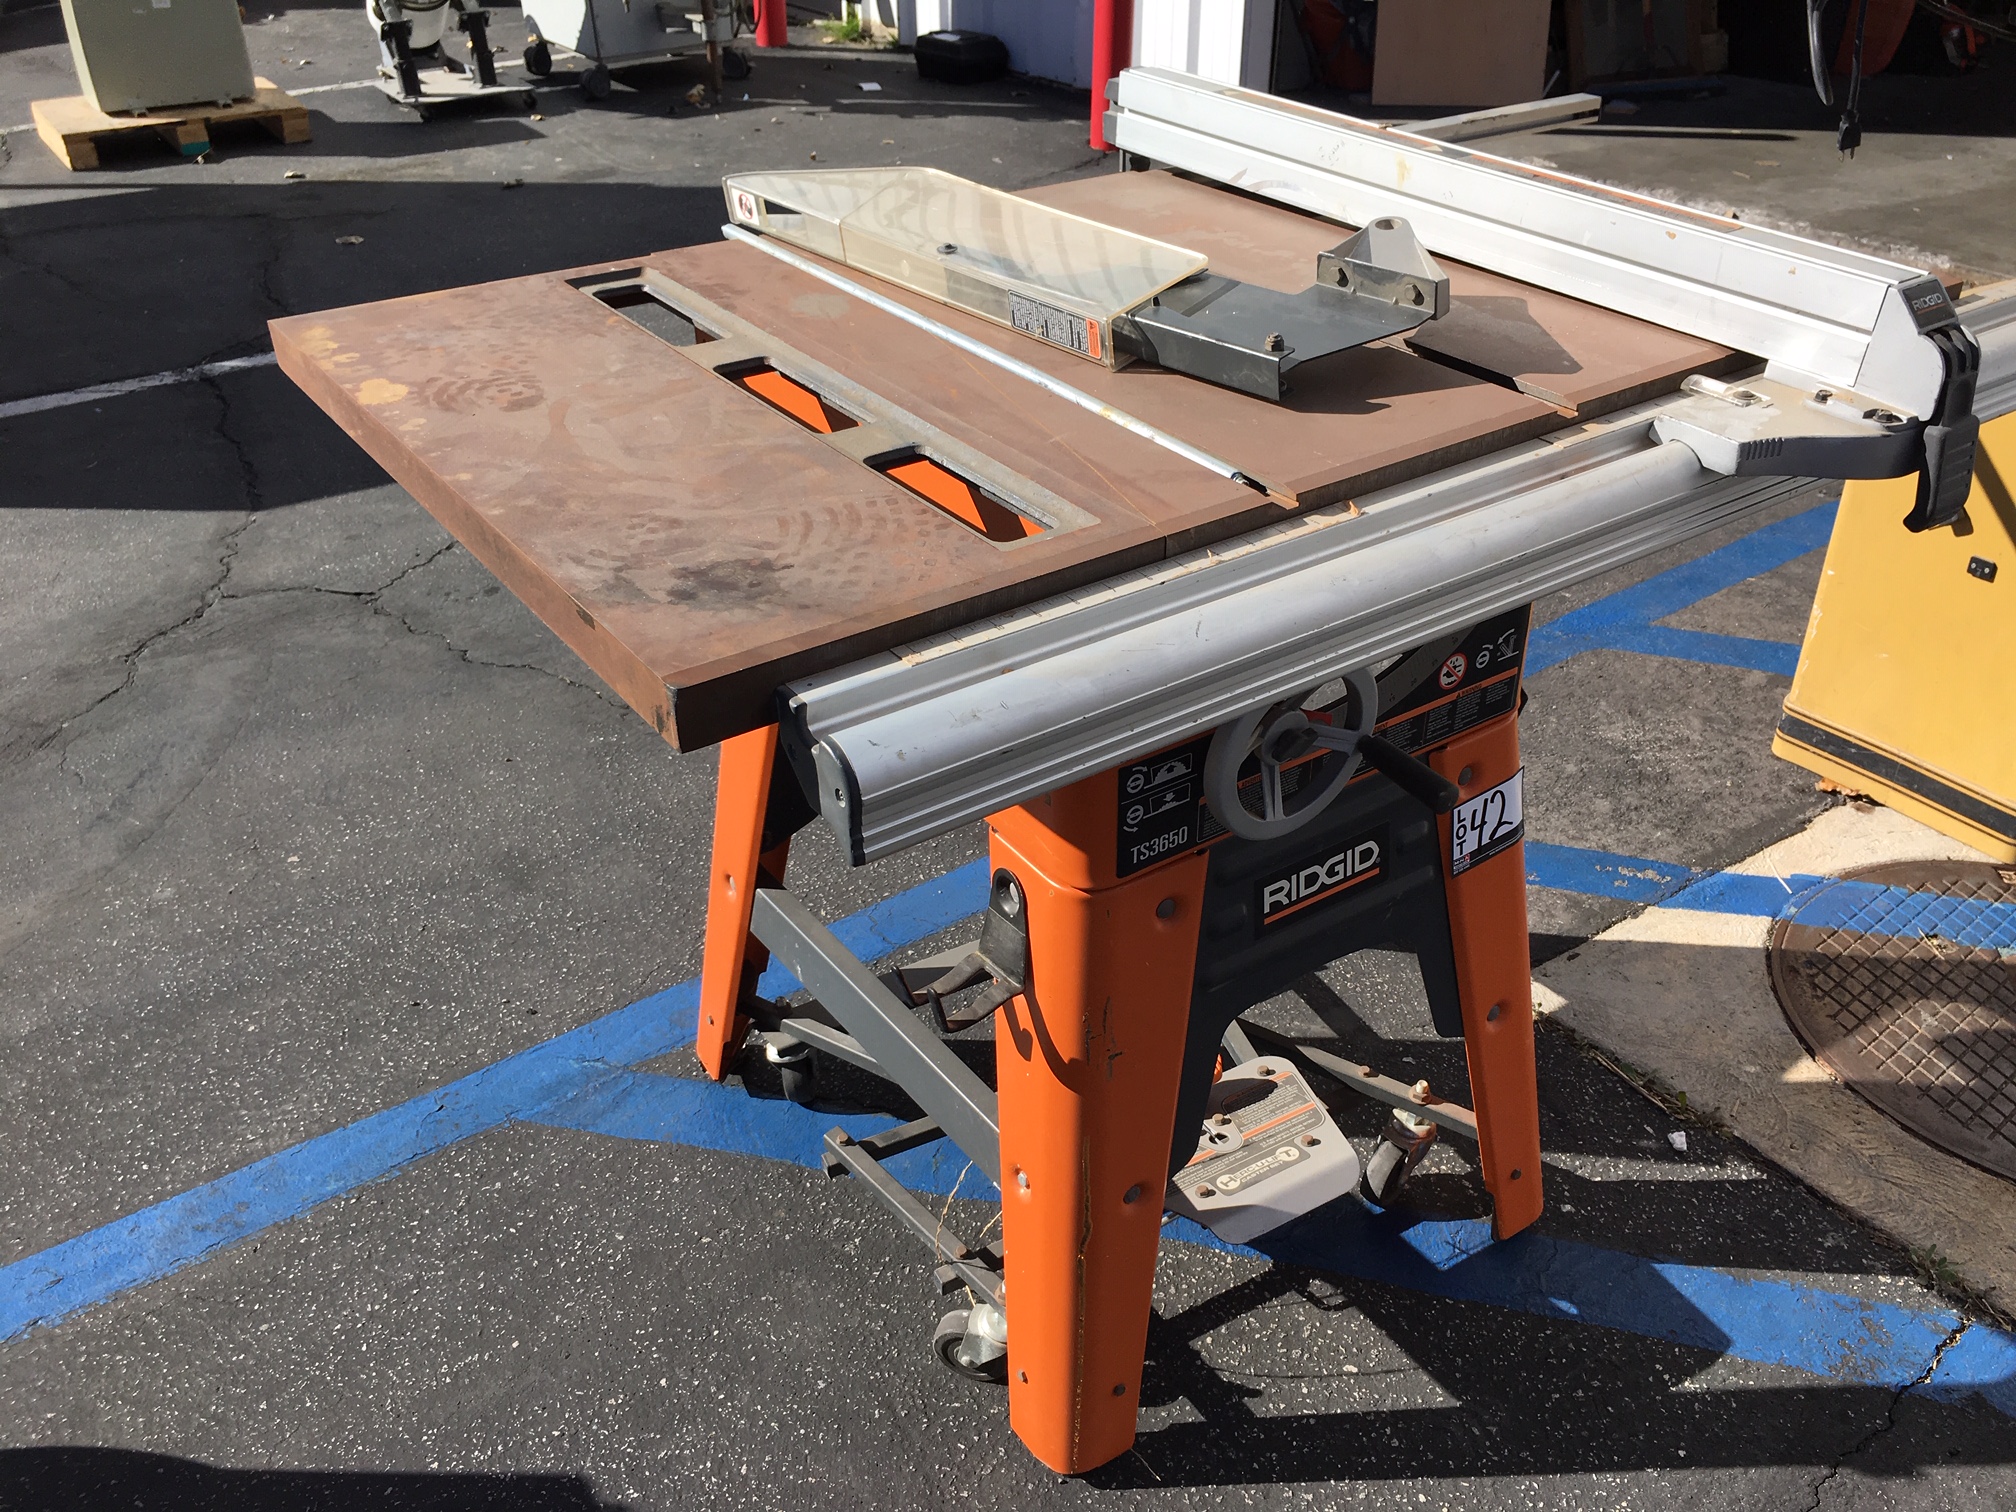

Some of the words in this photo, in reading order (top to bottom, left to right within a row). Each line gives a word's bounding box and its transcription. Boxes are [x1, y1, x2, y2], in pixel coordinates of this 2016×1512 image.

[1911, 293, 1943, 311] RIDGID
[1455, 809, 1467, 856] LOT
[1470, 790, 1513, 849] 42
[1130, 826, 1188, 864] TS3650
[1263, 840, 1380, 914] RIDGID
[1241, 1166, 1270, 1183] CASTER
[1270, 1160, 1284, 1168] SET
